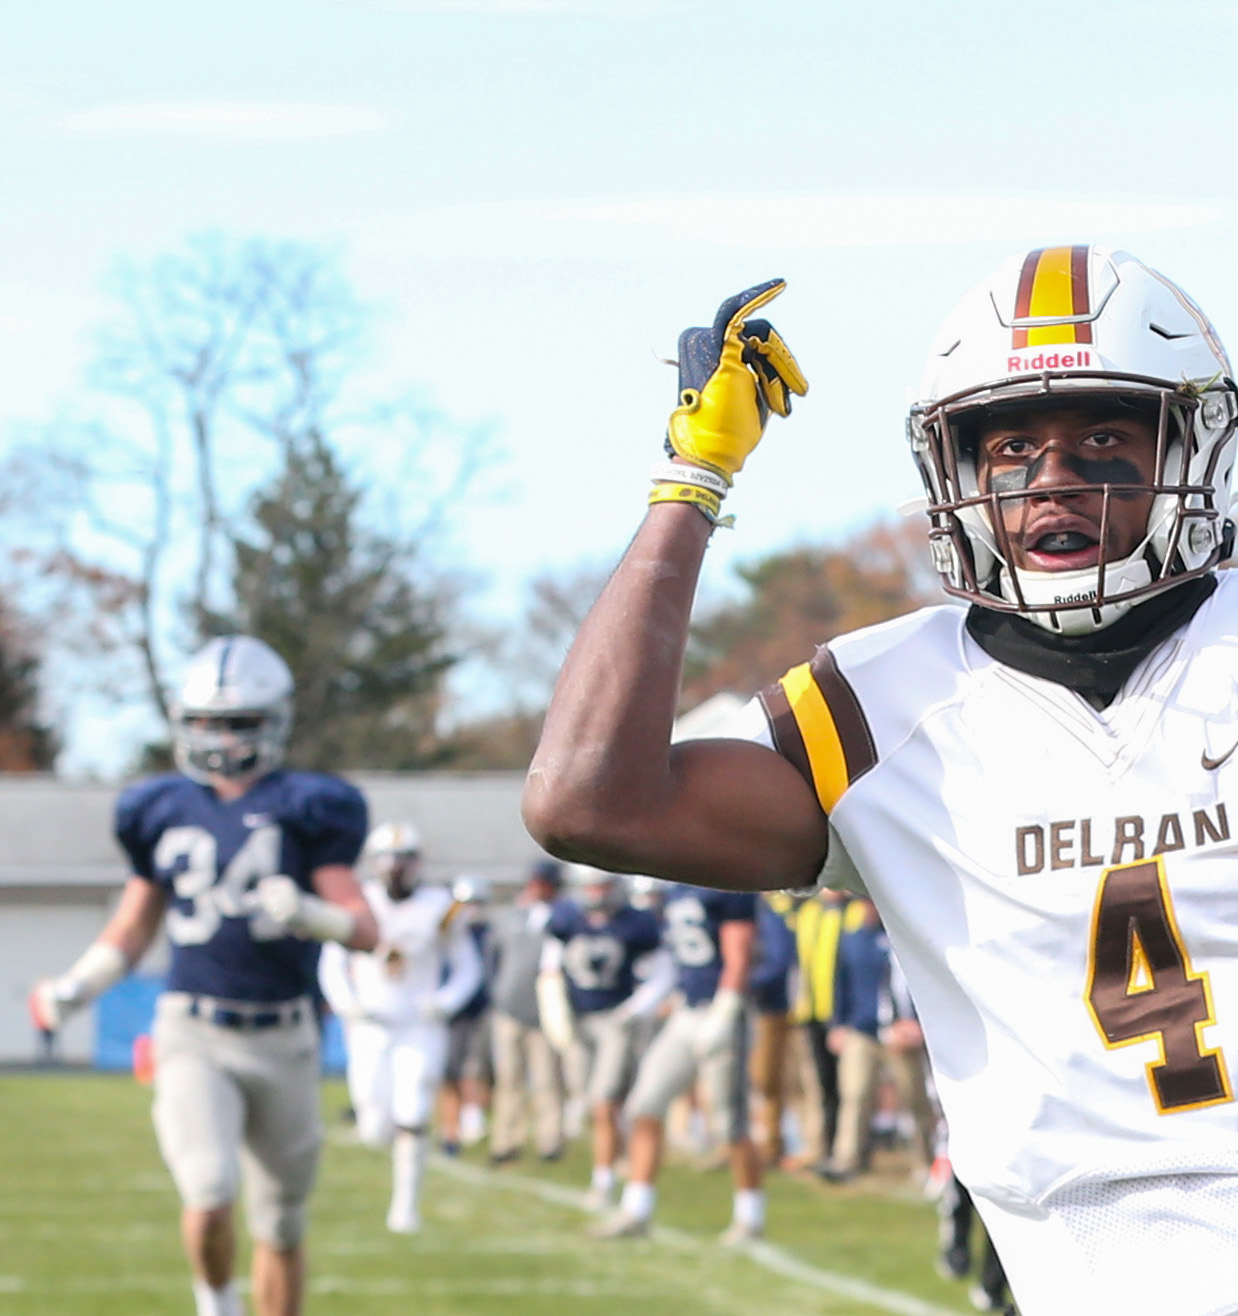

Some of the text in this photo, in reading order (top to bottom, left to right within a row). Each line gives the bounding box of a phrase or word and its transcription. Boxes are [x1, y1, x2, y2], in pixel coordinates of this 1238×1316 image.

[1007, 350, 1091, 373] Riddell
[154, 825, 290, 946] 34
[1015, 802, 1231, 877] DELRAN
[1083, 853, 1235, 1116] 4
